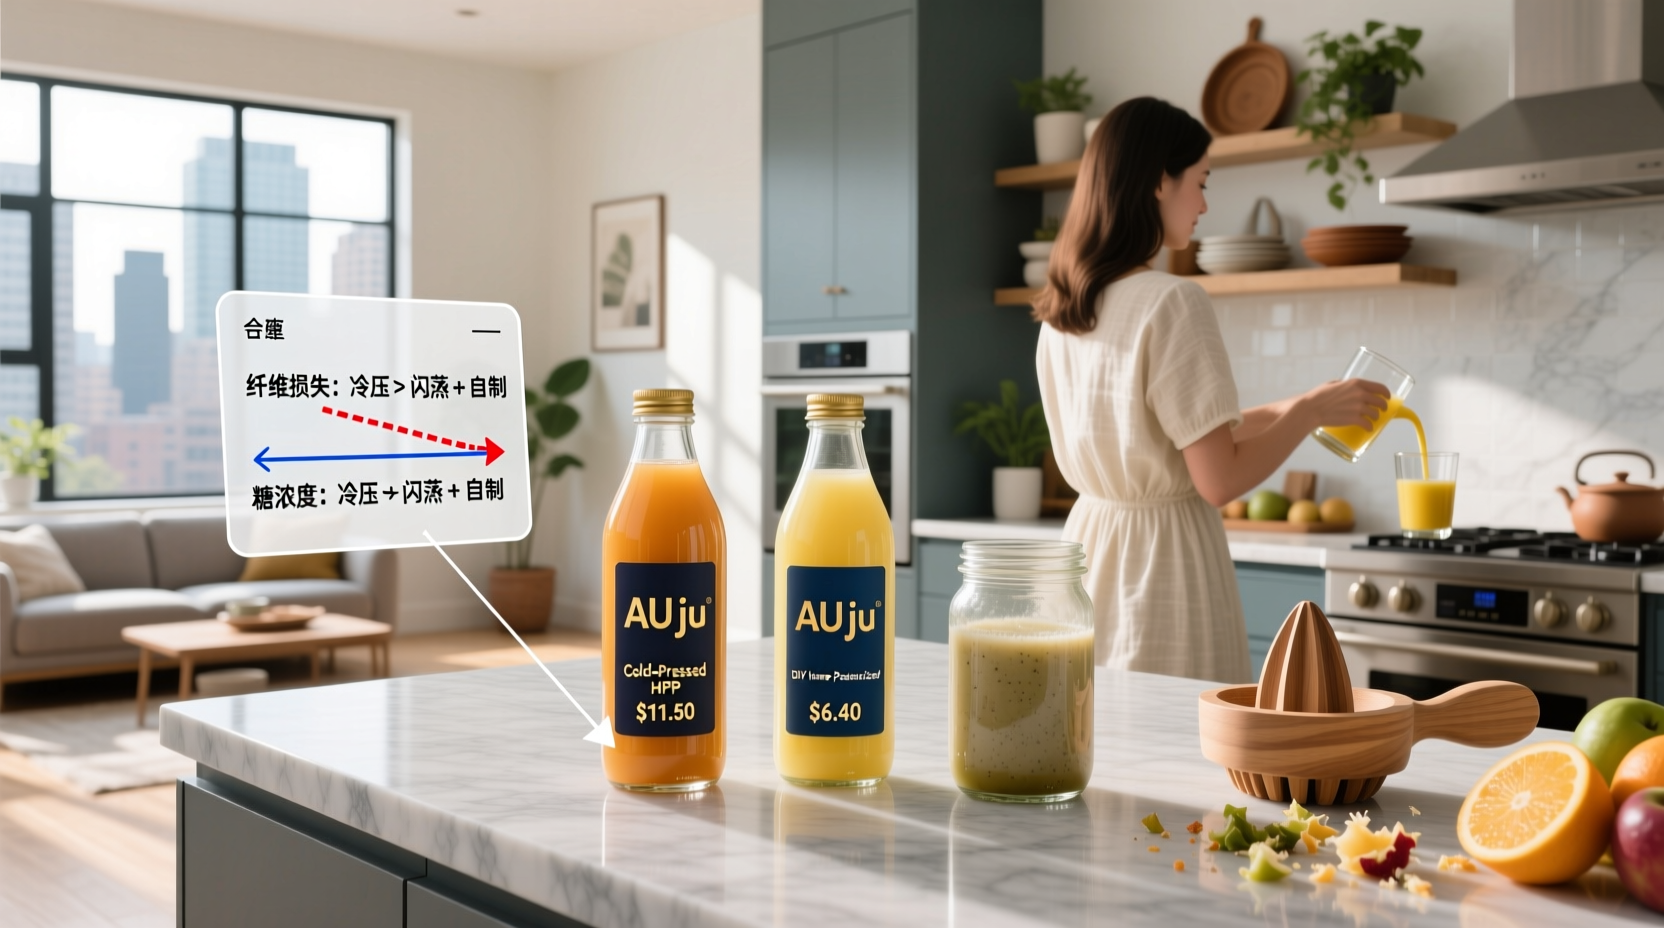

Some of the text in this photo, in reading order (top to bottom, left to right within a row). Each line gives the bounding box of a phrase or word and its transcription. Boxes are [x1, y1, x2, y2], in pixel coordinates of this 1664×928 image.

[651, 681, 681, 695] HPP
[636, 701, 695, 724] $11.50
[809, 700, 862, 724] $6.40
